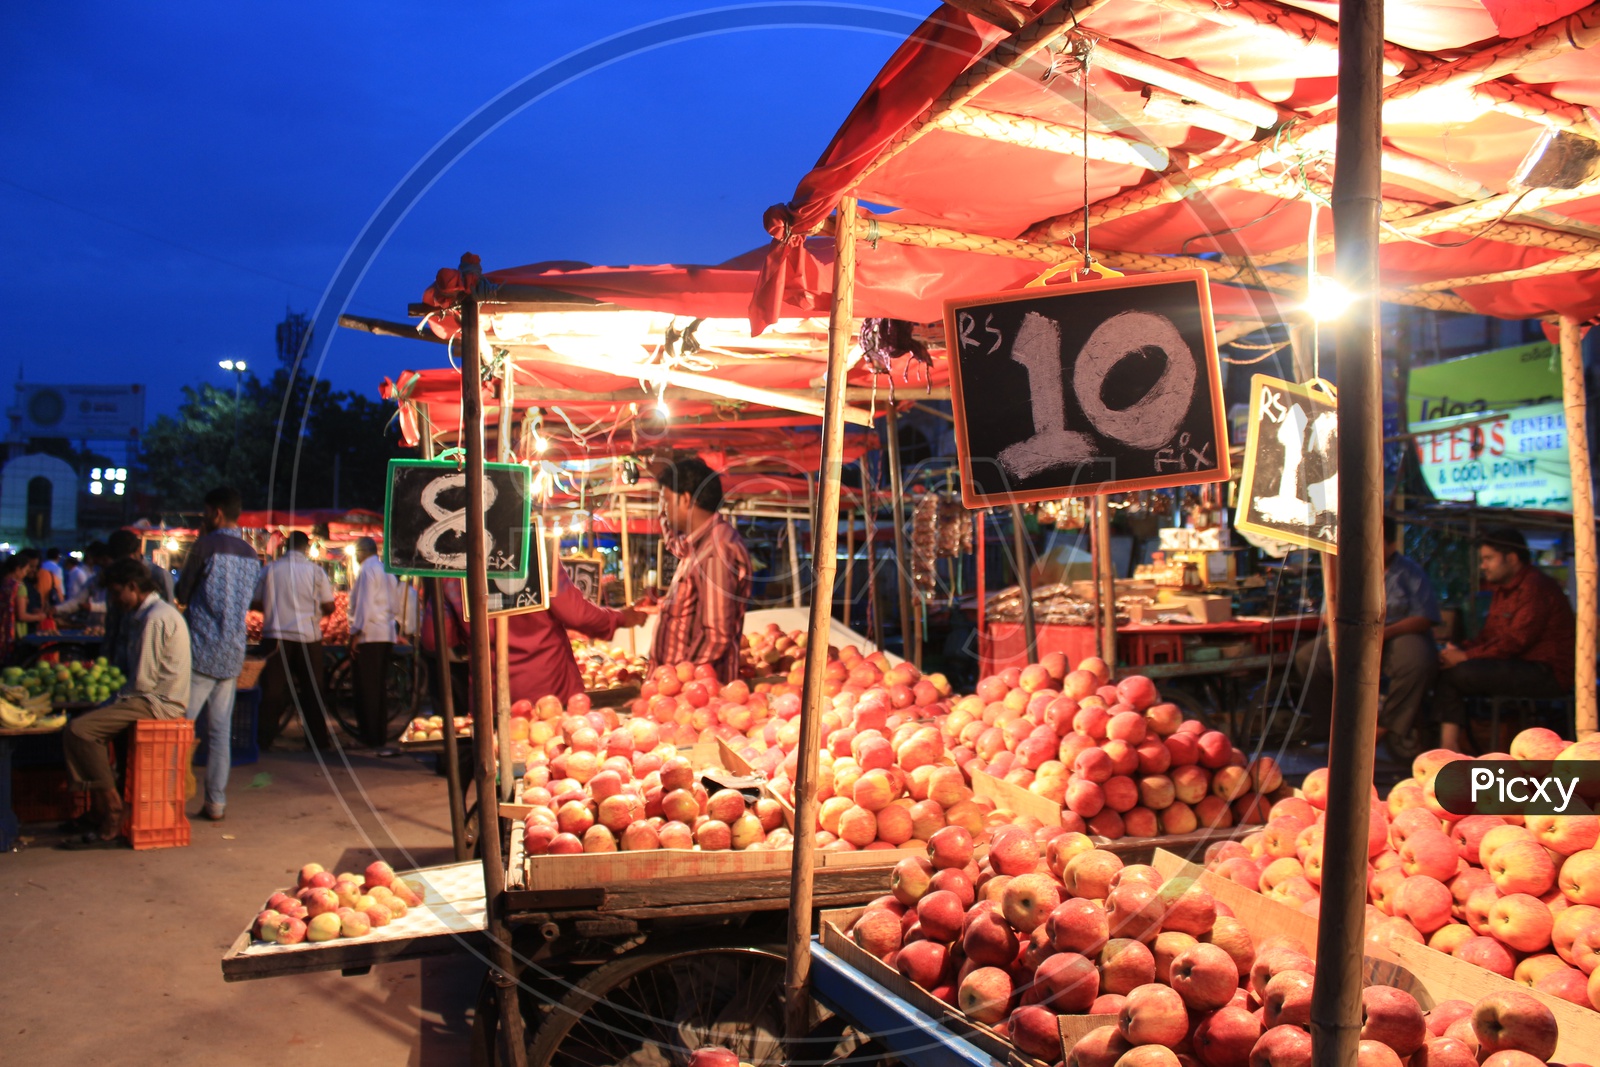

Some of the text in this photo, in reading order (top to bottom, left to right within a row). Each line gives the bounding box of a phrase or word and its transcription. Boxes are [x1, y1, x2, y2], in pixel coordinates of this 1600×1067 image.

[997, 309, 1197, 480] 10
[1511, 414, 1567, 435] GENERA
[1519, 433, 1563, 453] STORE
[1452, 463, 1488, 482] COOL
[1493, 458, 1537, 479] POINT
[416, 473, 498, 570] 8
